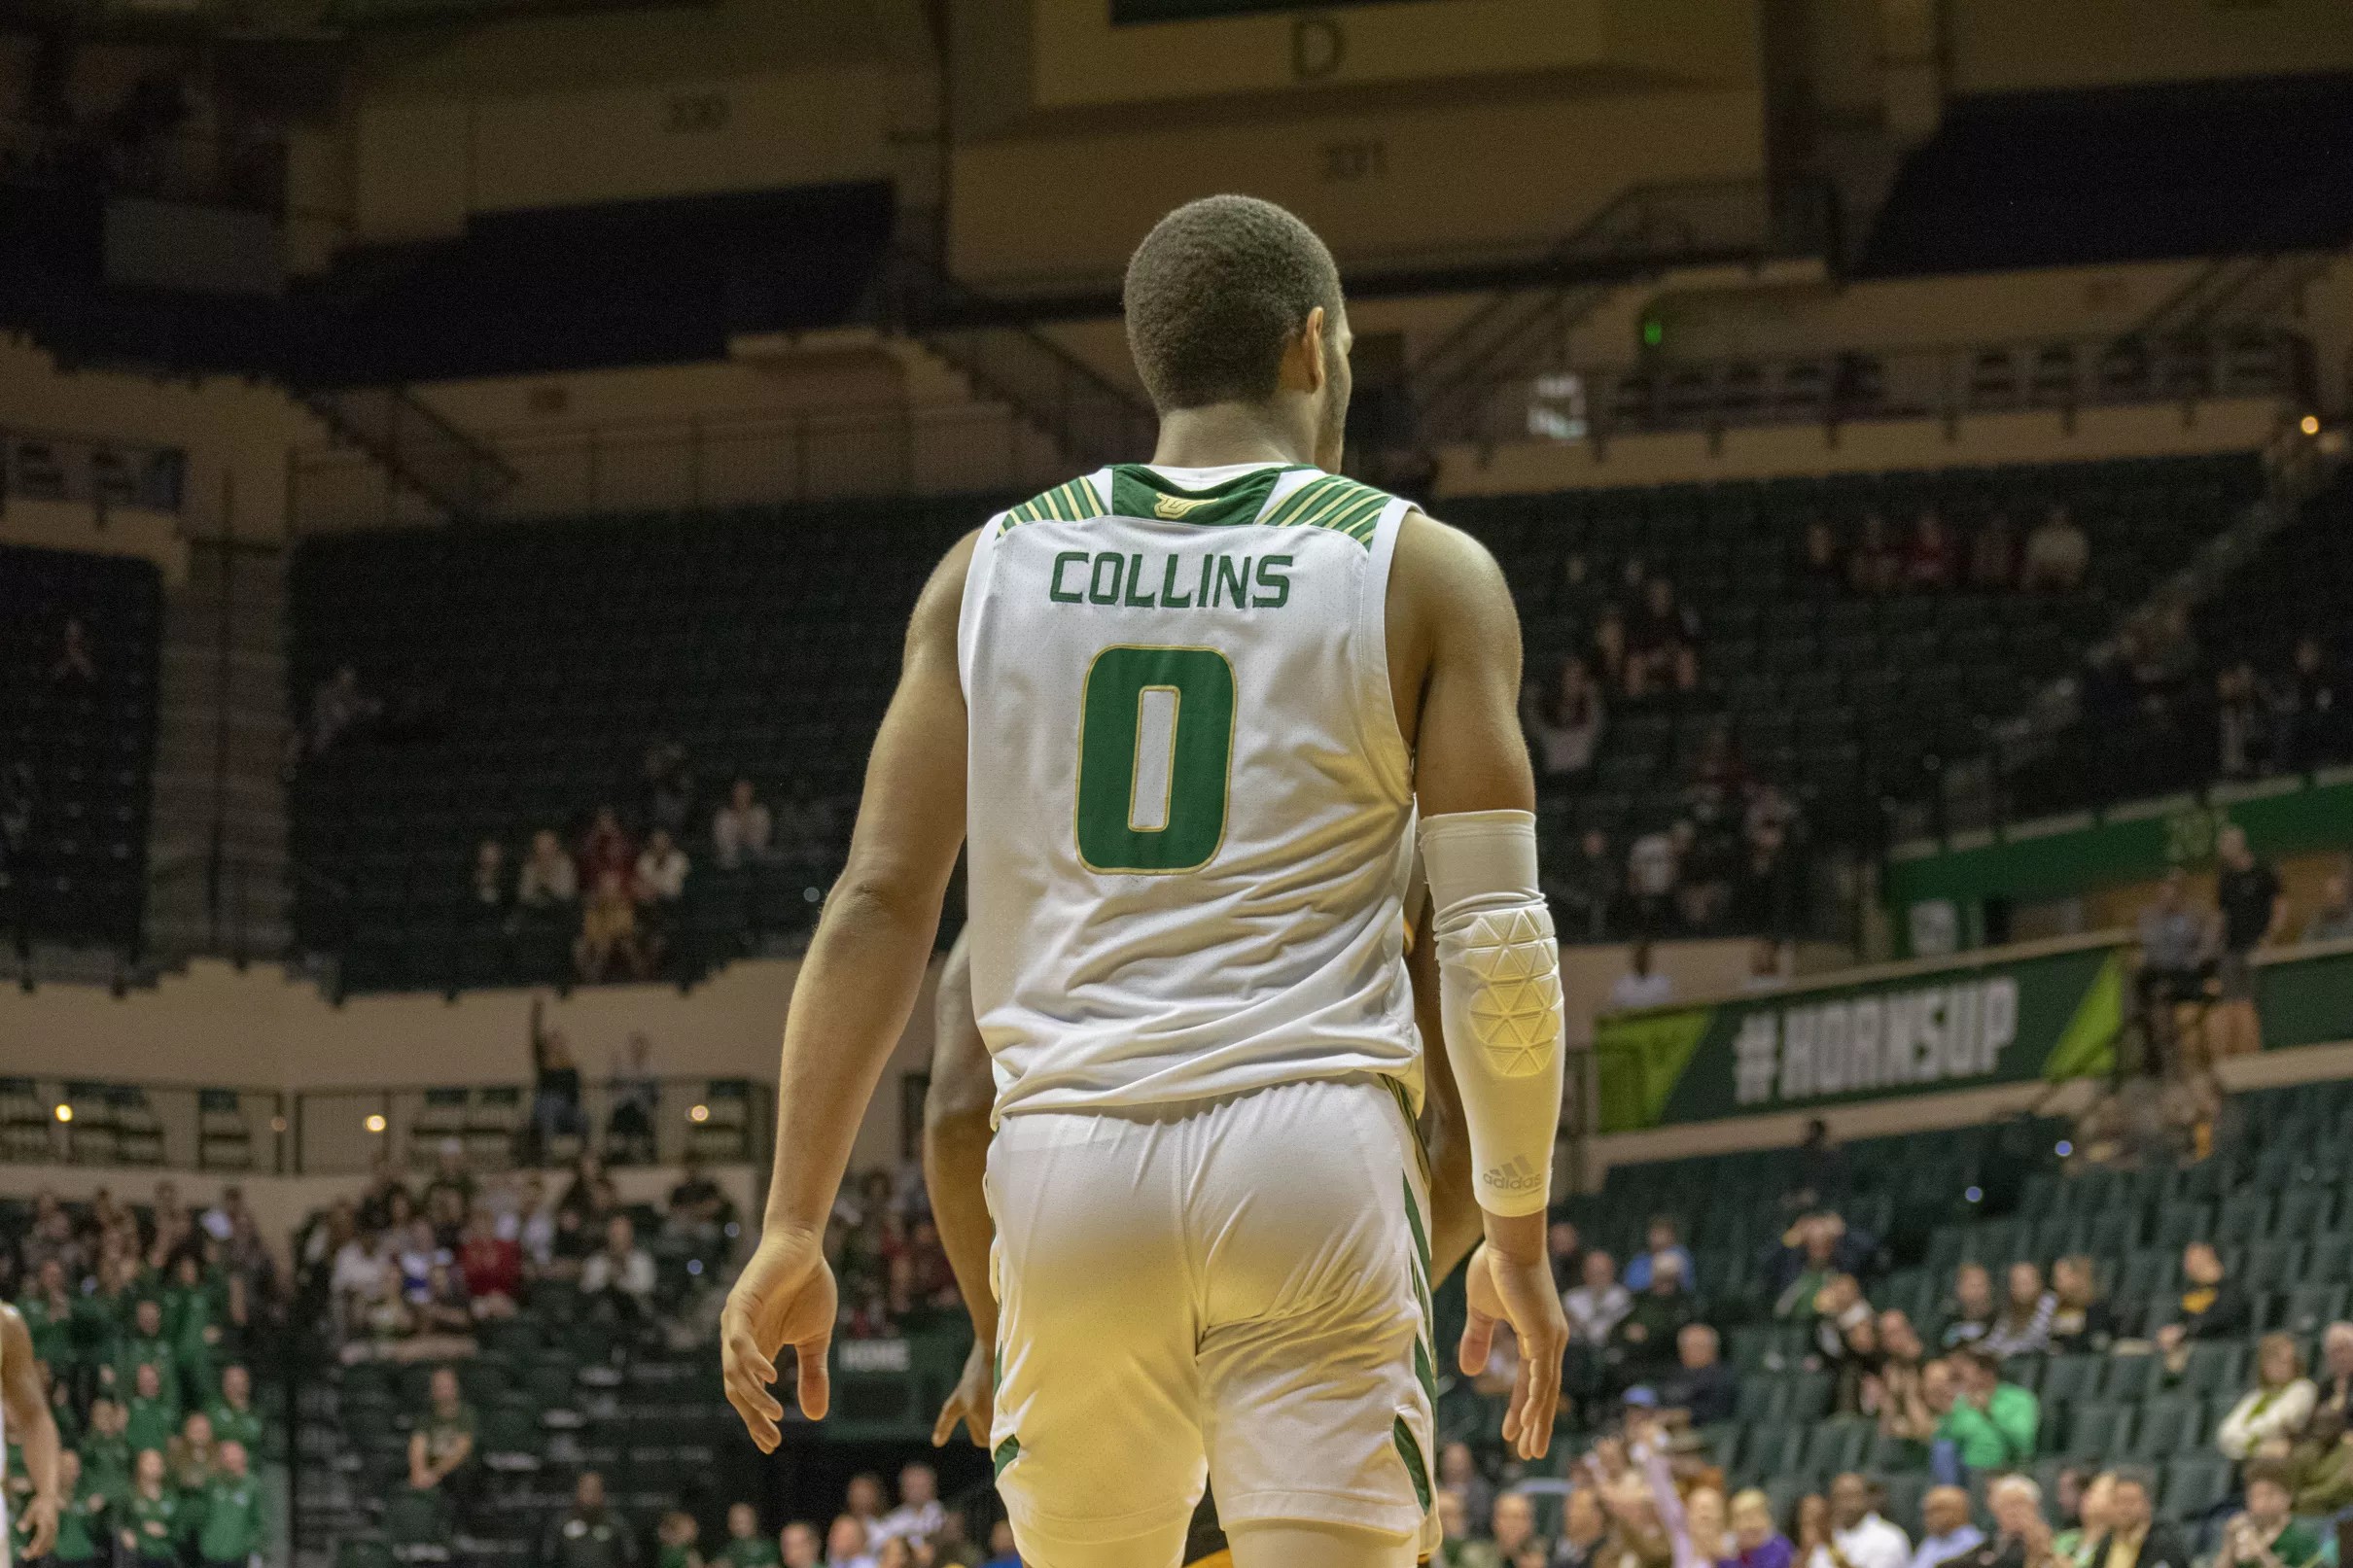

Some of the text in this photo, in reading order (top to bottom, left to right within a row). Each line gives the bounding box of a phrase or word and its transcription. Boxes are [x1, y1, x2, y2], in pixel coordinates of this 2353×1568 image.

[1292, 19, 1346, 78] D
[1050, 551, 1293, 609] COLLINS
[1073, 643, 1238, 875] 0
[1734, 975, 2019, 1105] #HORNSUP
[1483, 1172, 1541, 1190] adidas
